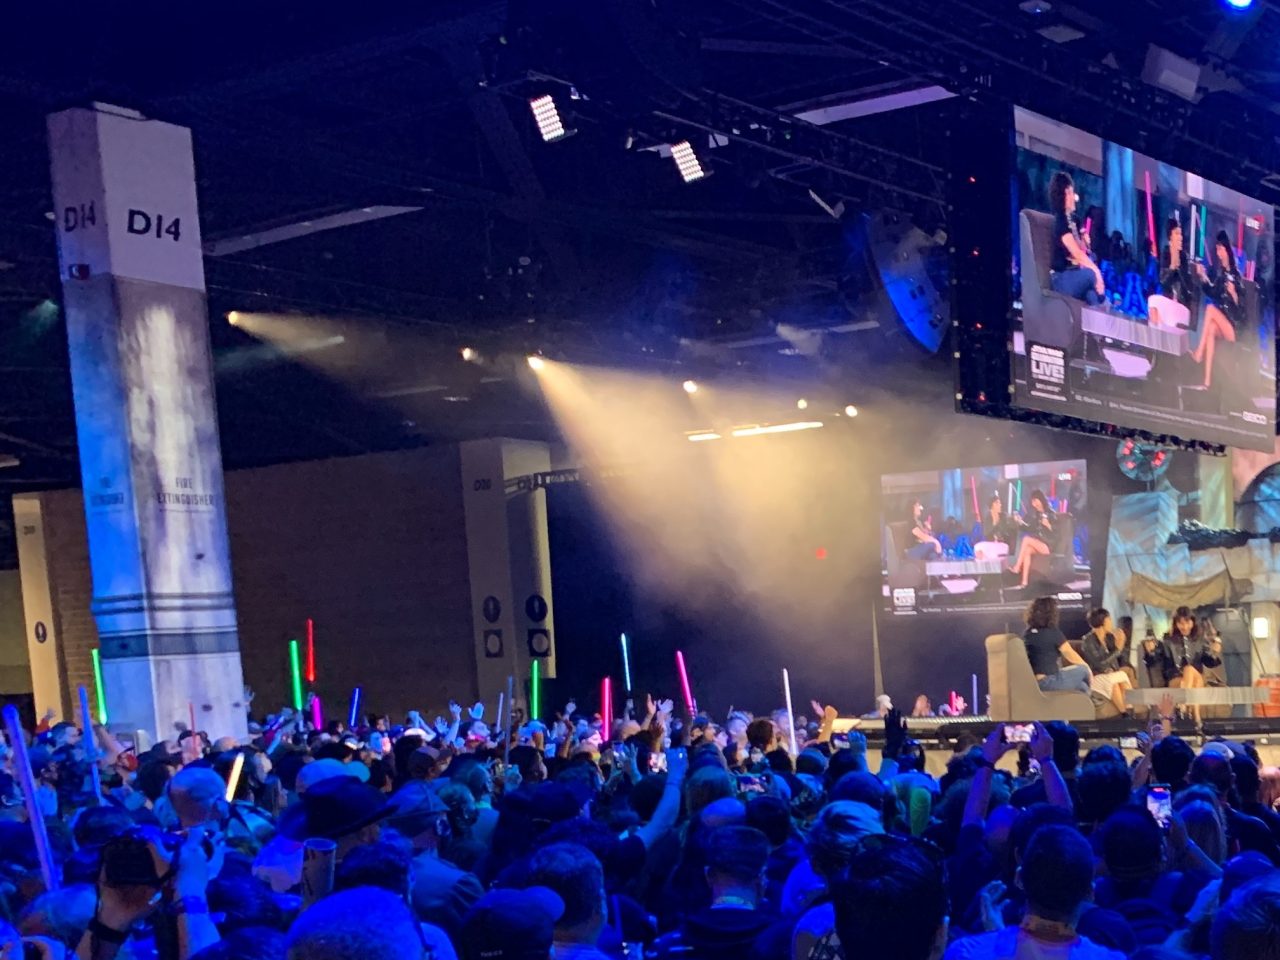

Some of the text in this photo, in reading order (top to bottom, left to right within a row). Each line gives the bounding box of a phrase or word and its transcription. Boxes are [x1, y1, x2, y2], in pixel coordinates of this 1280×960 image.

[65, 200, 96, 232] D14
[127, 209, 181, 241] D14
[175, 476, 193, 490] FIRE
[157, 491, 214, 507] EXTINGUISHER
